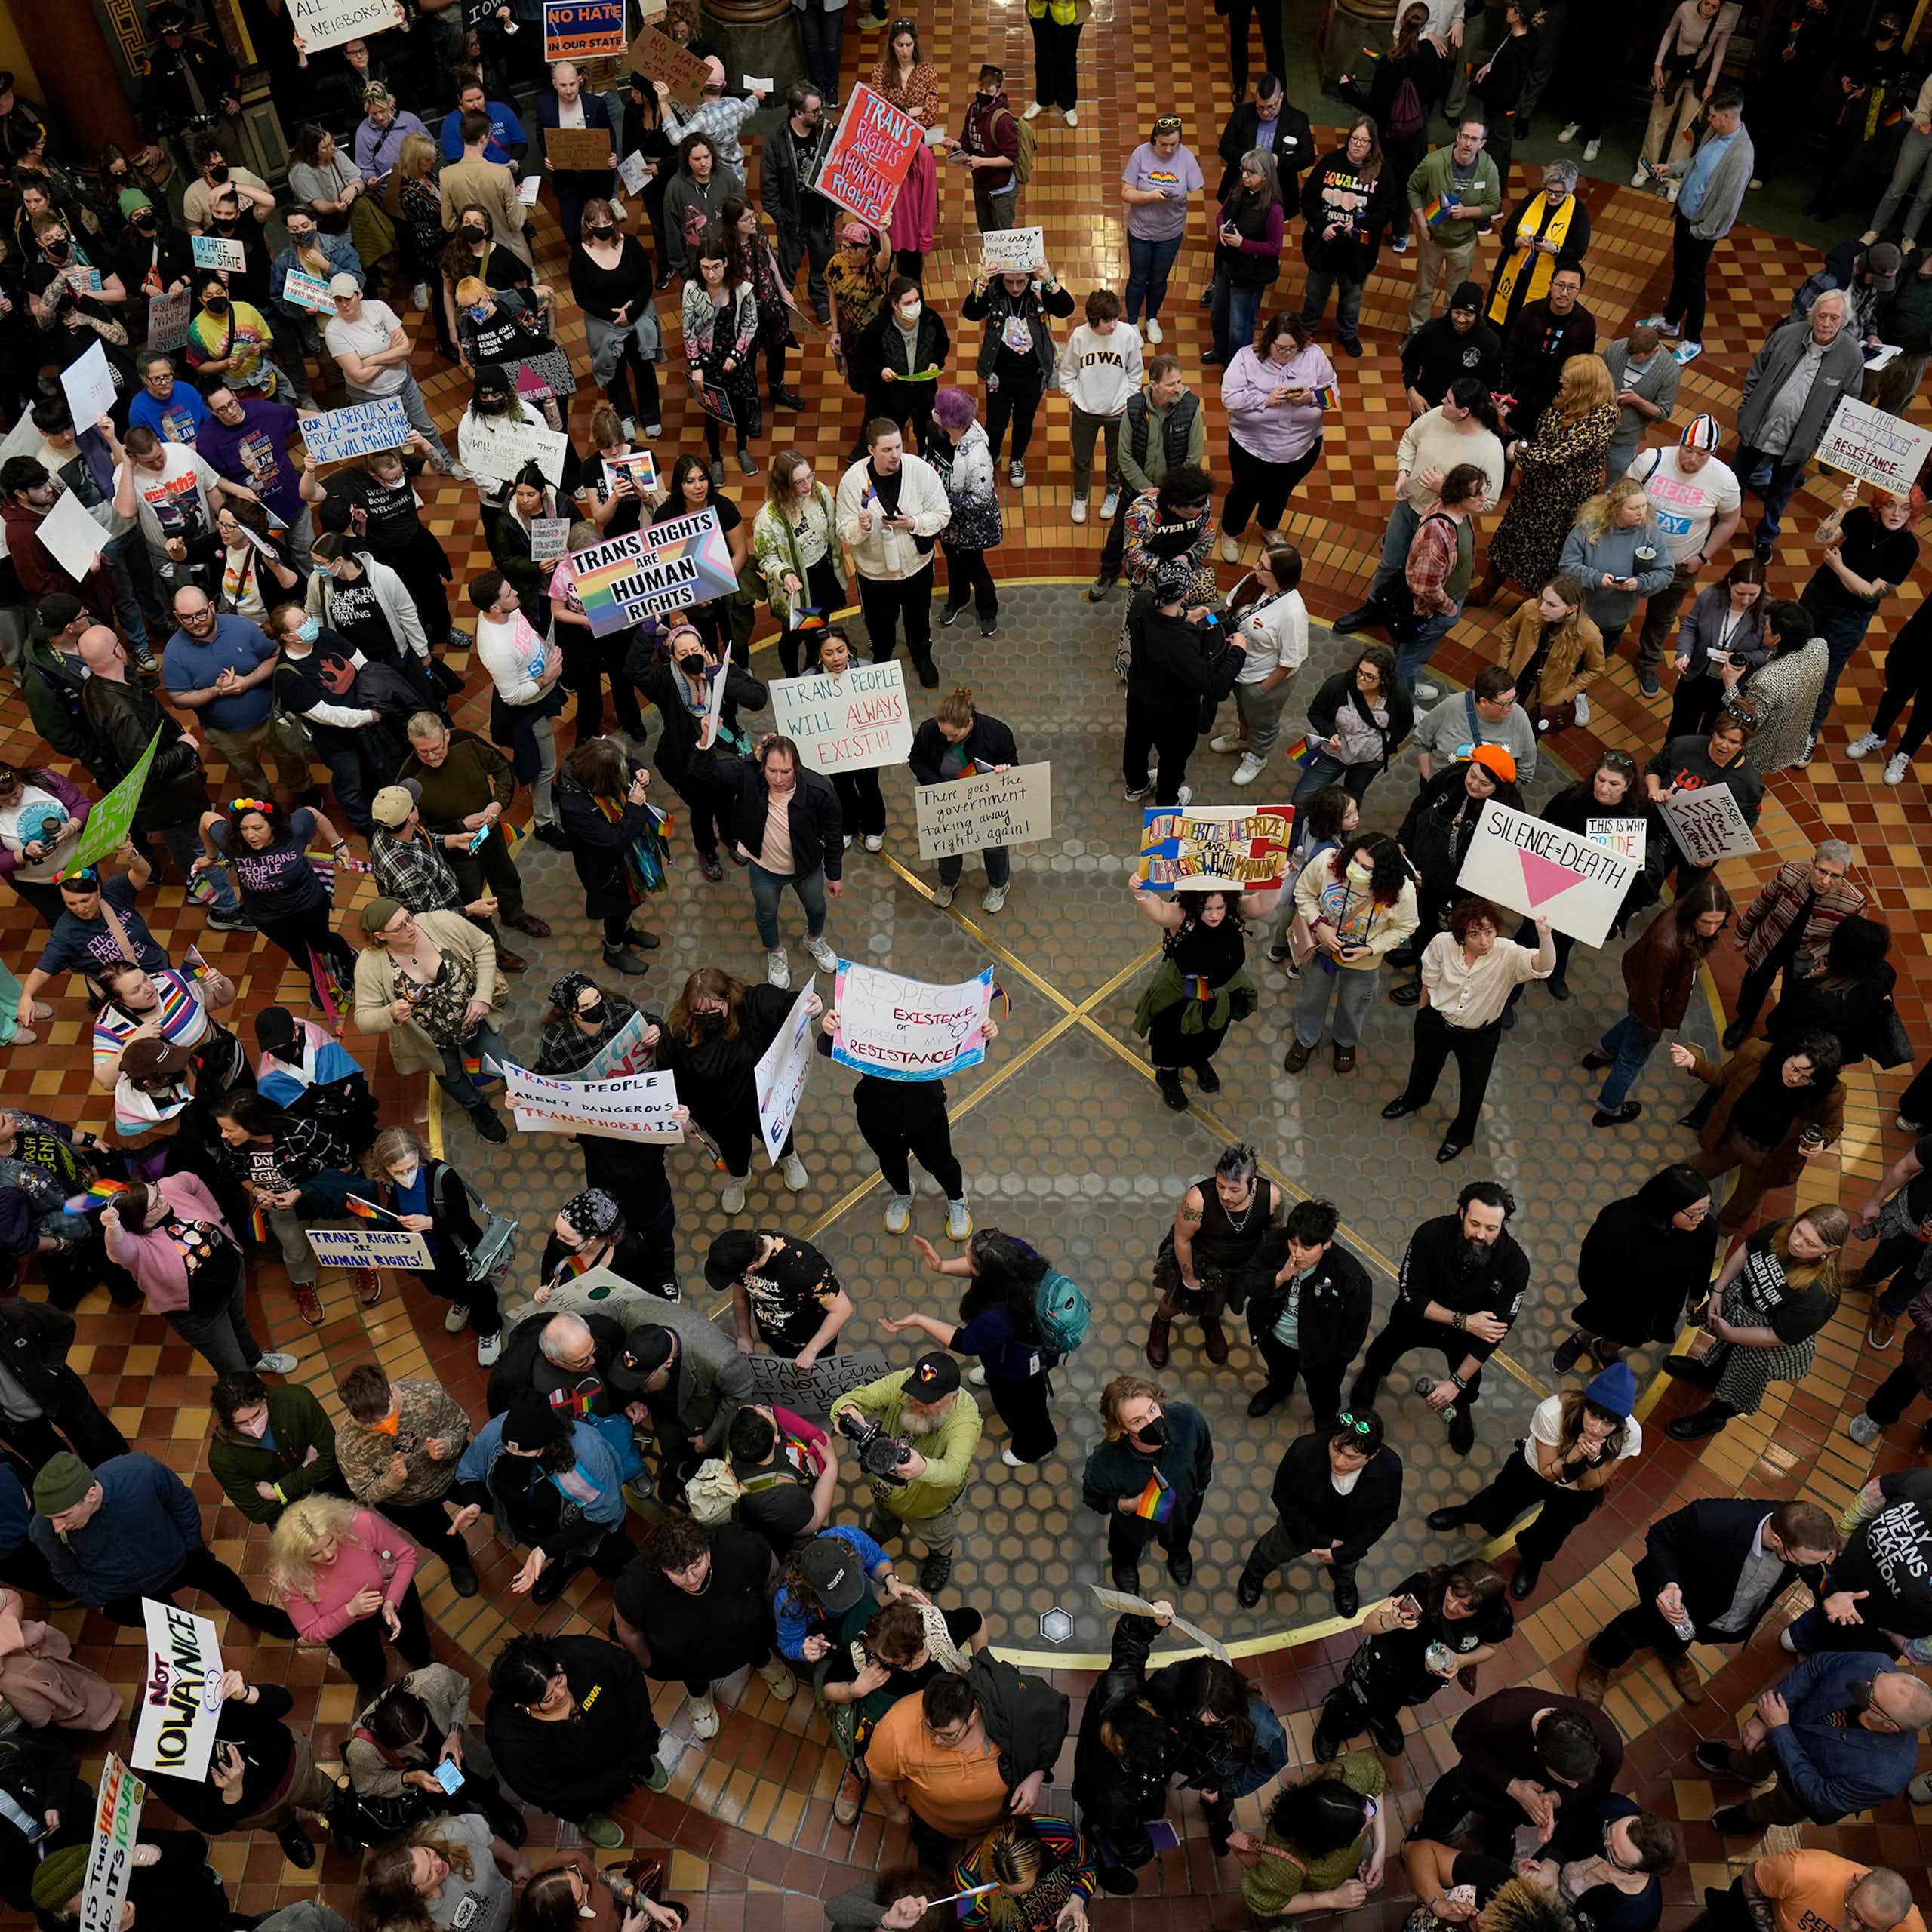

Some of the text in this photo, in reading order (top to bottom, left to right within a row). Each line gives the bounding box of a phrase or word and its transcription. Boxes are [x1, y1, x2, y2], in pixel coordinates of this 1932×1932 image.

[310, 1, 390, 38] NEIGBORS!
[548, 5, 622, 24] NO HATE
[549, 36, 621, 51] IN OUR STATE
[650, 35, 706, 77] NO HATE
[641, 60, 682, 90] STATE
[652, 52, 690, 82] IN OUR
[861, 94, 915, 147] TRANS
[850, 140, 885, 168] ARE
[855, 118, 904, 168] RIGHTS
[841, 155, 894, 207] HUMAN
[192, 237, 229, 254] NO HATE
[217, 254, 242, 269] STATE
[477, 331, 497, 342] ERROR
[478, 328, 516, 349] GENDER NOT
[479, 346, 503, 356] FOUND.
[1080, 351, 1124, 369] IOWA
[303, 418, 323, 434] OUR
[389, 398, 401, 414] WE
[1871, 411, 1897, 432] OUR
[177, 425, 196, 441] LAW
[306, 425, 340, 447] PRIZE
[361, 422, 380, 436] OUR
[472, 439, 491, 452] WILL
[1841, 417, 1912, 451] EXISTENCE
[1864, 440, 1878, 453] IS
[255, 452, 274, 469] LAW
[315, 435, 368, 463] WE WILL
[537, 442, 560, 456] THEY
[1833, 437, 1899, 475] RESISTANCE
[368, 495, 390, 506] BODY
[1649, 475, 1701, 506] HERE
[572, 537, 641, 575] TRANS
[650, 514, 714, 548] RIGHTS
[636, 552, 660, 570] ARE
[343, 588, 360, 598] ARE
[612, 557, 697, 605] HUMAN
[331, 596, 355, 606] ONES
[332, 605, 355, 614] BEEN
[628, 586, 693, 622] RIGHTS
[333, 609, 371, 622] WAITING
[777, 666, 901, 707] TRANS PEOPLE
[787, 694, 903, 737] WILL ALWAYS
[918, 774, 1024, 806] There goes the
[936, 786, 1026, 822] government
[921, 810, 1011, 838] taking away
[934, 820, 1029, 854] rights again!
[1149, 814, 1284, 843] OUR LIBERTIES WE PRIZE
[1589, 819, 1643, 832] THIS IS WHY
[1204, 839, 1226, 853] AND
[1487, 811, 1629, 890] SILENCE=DEATH
[1680, 821, 1710, 859] WRONG
[238, 863, 284, 876] PEOPLE
[260, 849, 297, 864] TRANS
[849, 967, 967, 1011] RESPECT
[893, 1005, 974, 1026] EXISTENCE
[848, 1023, 942, 1047] EXPECT MY
[849, 1038, 963, 1066] RESISTANCE!
[512, 1064, 658, 1094] TRANS PEOPLE
[513, 1090, 674, 1115] AREN'T DANGEROUS
[655, 1120, 681, 1132] IS
[309, 1232, 411, 1247] TRANS RIGHTS
[352, 1244, 372, 1253] ARE
[318, 1250, 424, 1269] HUMAN RIGHTS!
[1764, 1252, 1786, 1287] QUEER
[1749, 1250, 1783, 1306] LIBERATION
[749, 1355, 858, 1380] EPARATE
[782, 1376, 822, 1392] NOT
[826, 1361, 892, 1384] EQUAL!
[1898, 1500, 1932, 1544] ALLY
[1872, 1512, 1905, 1569] TAKE
[1884, 1507, 1929, 1578] MEANS
[149, 1651, 169, 1707] NOT
[155, 1606, 205, 1768] IOWA NICE
[582, 1684, 602, 1712] IOWA
[96, 1754, 122, 1838] HELL?
[115, 1772, 134, 1851] IOWA
[89, 1832, 110, 1888] THIS
